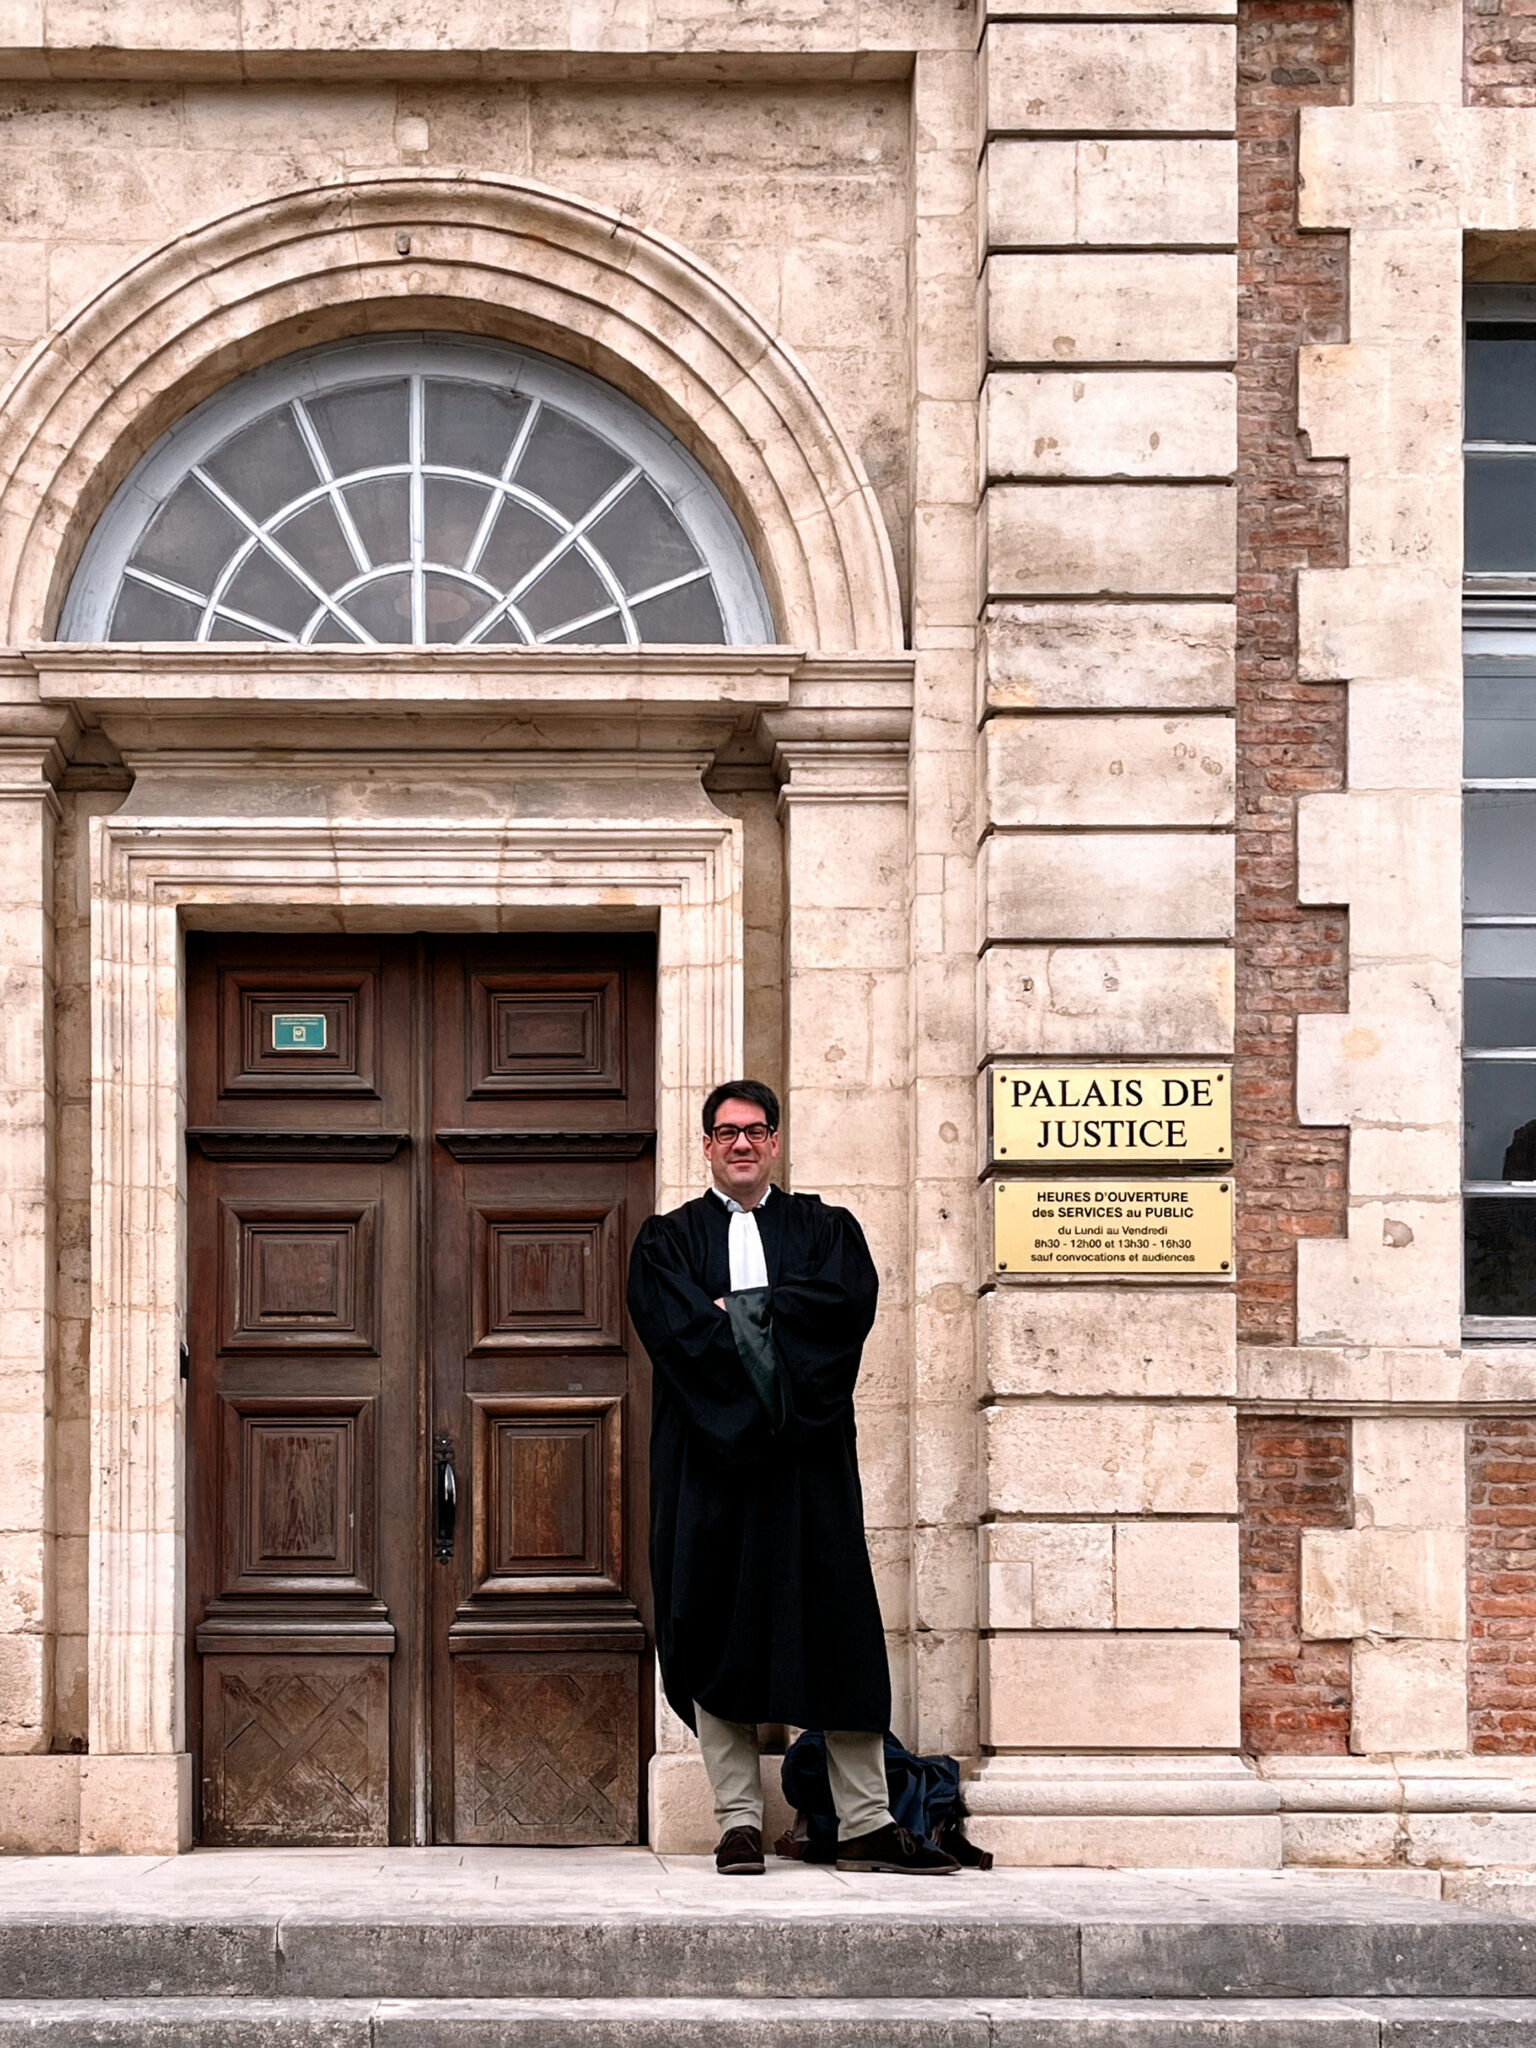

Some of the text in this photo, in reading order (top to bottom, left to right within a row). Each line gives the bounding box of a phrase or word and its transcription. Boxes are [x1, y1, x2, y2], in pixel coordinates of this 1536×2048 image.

[1011, 1080, 1213, 1107] PALAIS DE
[1037, 1120, 1188, 1148] JUSTICE
[1037, 1191, 1189, 1203] HEURES D'OUVERTURE
[1032, 1207, 1194, 1218] des SERVICES au PUBLIC
[1057, 1225, 1168, 1236] du Lundi au Vendredi
[1034, 1238, 1061, 1249] 8h30
[1070, 1238, 1102, 1249] 12h00
[1104, 1239, 1115, 1249] et
[1118, 1238, 1150, 1249] 13h30
[1160, 1238, 1192, 1249] 16h30
[1030, 1252, 1196, 1262] sauf convocations et audiences
